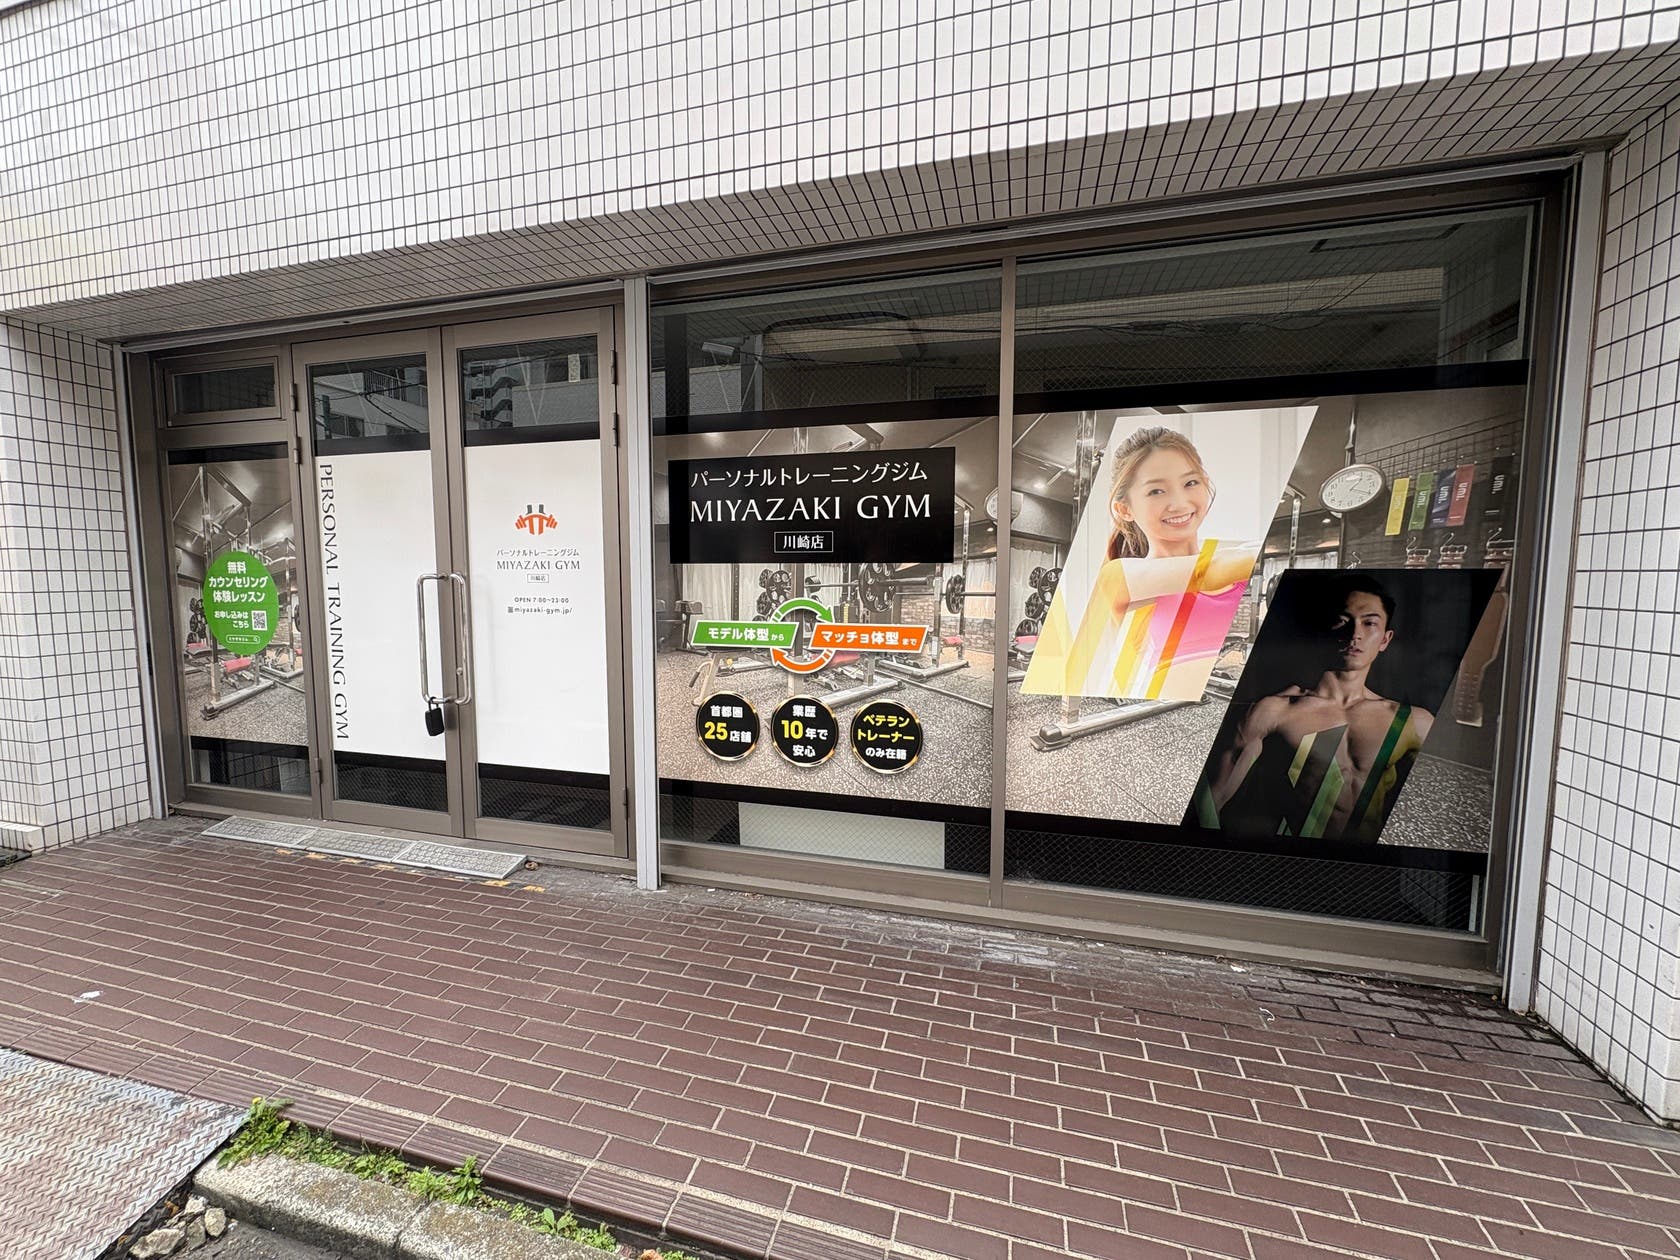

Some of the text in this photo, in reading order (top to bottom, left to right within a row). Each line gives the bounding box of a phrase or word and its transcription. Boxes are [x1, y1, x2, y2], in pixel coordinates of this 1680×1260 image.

[691, 462, 928, 488] パーソナルトレーニングジム
[690, 494, 931, 522] MIYAZAKI GYM
[783, 534, 825, 549] 川崎店
[497, 549, 579, 557] パーソナルトレーニングジム
[227, 561, 247, 574] 無料
[497, 560, 580, 570] MIYAZAKI GYM
[208, 576, 269, 588] カウンセリング
[213, 590, 266, 603] 体験レッスン
[320, 464, 349, 738] PERSONAL TRAINING GYM
[214, 610, 249, 619] お申し込みは
[232, 620, 249, 628] こちら
[710, 705, 743, 718] 首都圏
[857, 729, 915, 743] トレーナー
[792, 744, 816, 757] 安心
[865, 747, 907, 760] のみ在籍
